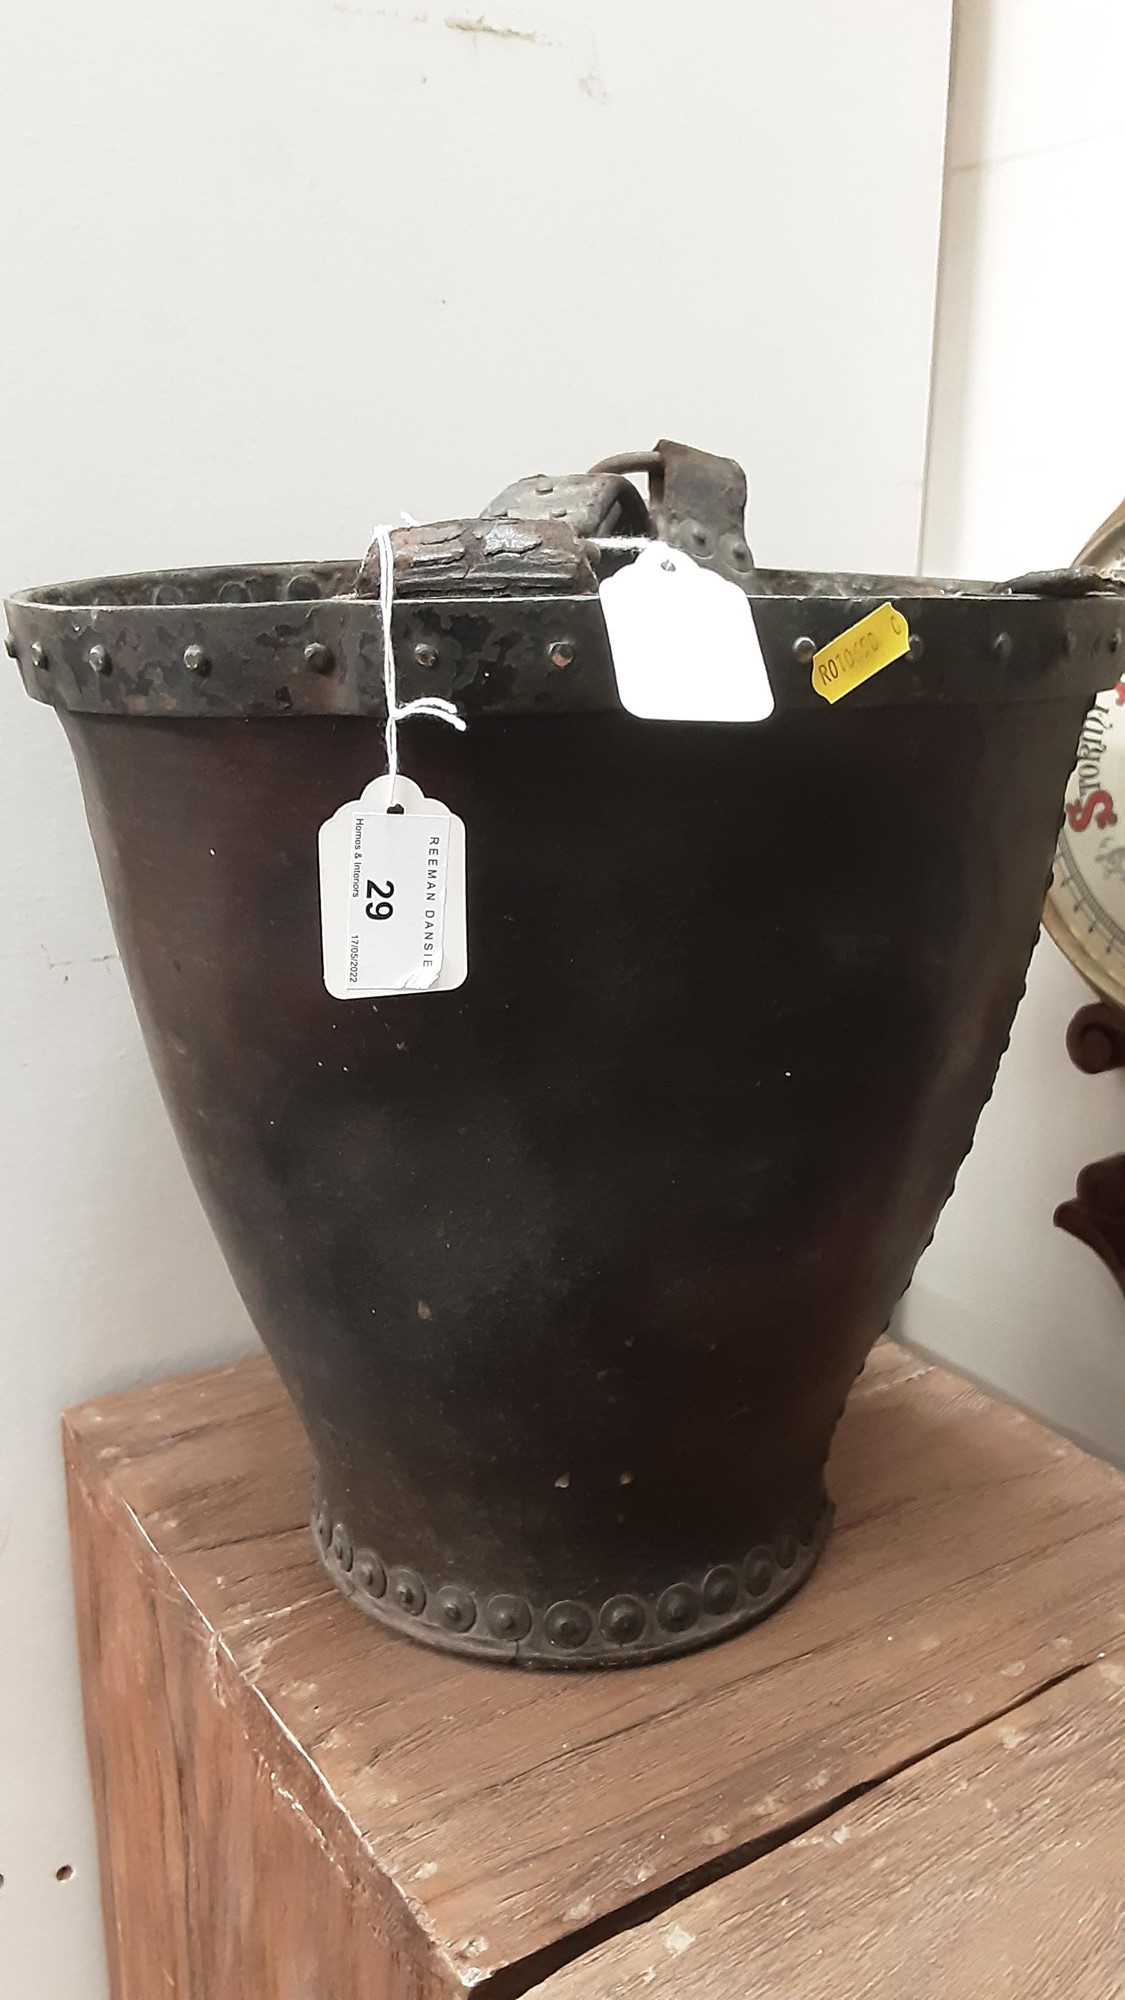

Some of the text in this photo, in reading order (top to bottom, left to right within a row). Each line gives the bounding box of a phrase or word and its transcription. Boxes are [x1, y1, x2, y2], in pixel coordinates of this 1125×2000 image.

[354, 818, 364, 850] Homes
[352, 862, 362, 898] Interiors
[365, 879, 395, 921] 29
[422, 836, 440, 967] REEMAN DANSIE
[349, 934, 359, 983] 17/05/2022
